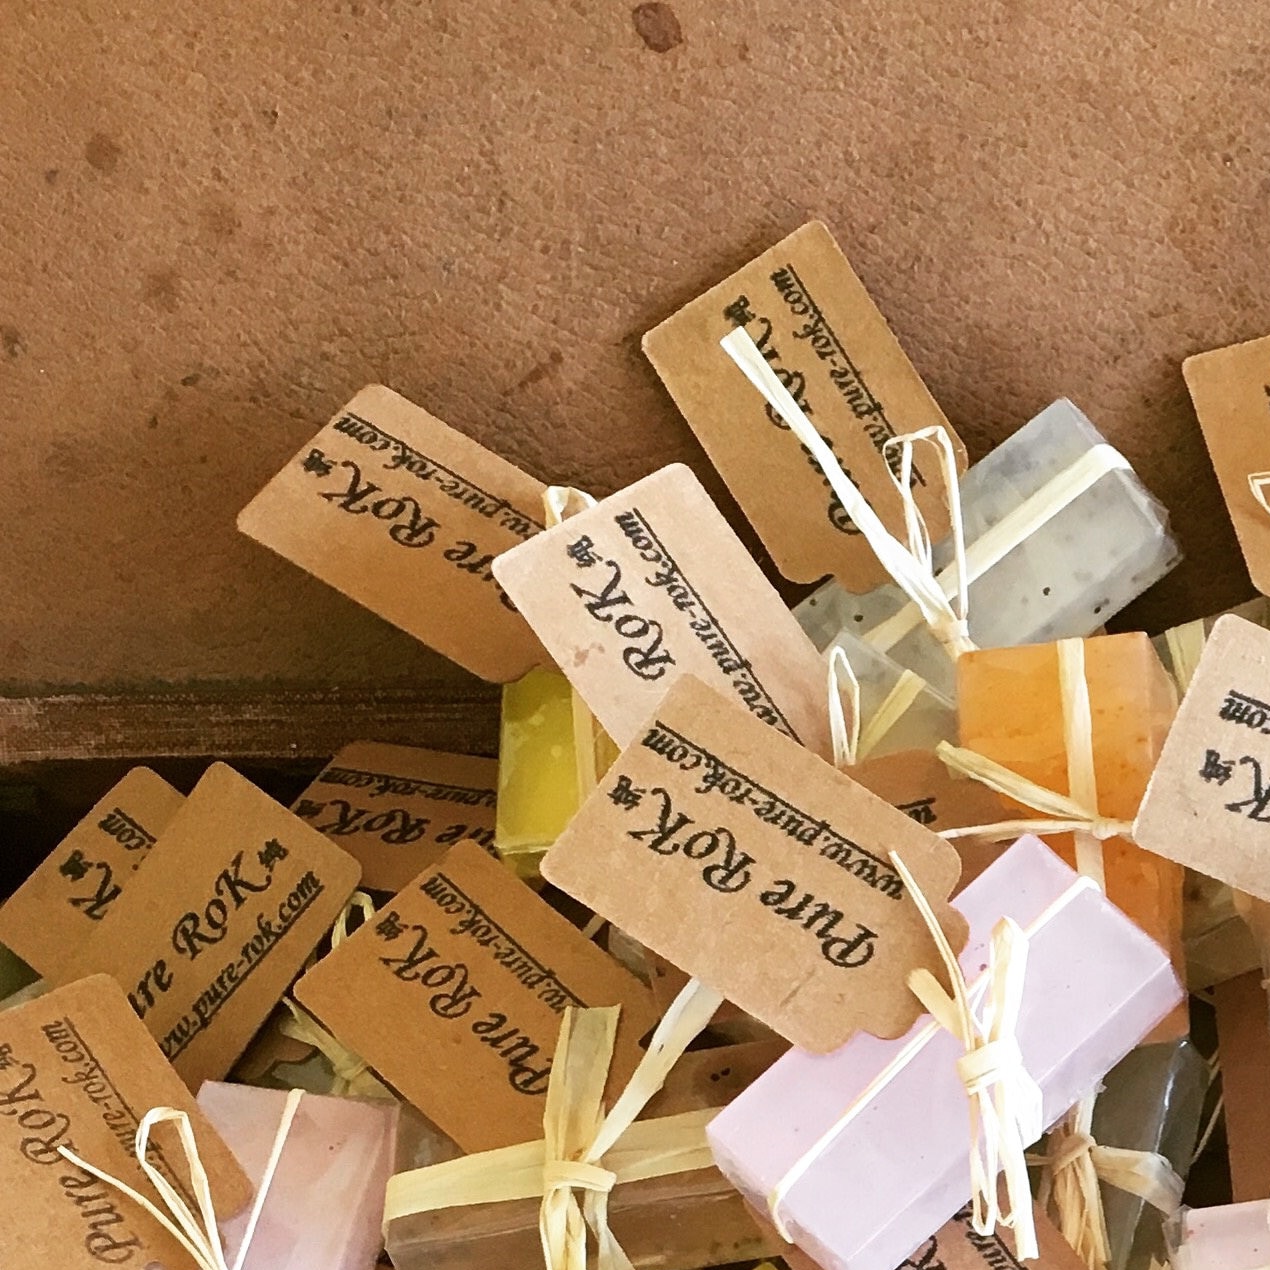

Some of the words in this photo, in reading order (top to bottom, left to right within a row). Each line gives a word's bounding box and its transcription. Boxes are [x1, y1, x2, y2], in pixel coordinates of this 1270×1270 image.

[317, 460, 441, 548] RoK
[570, 560, 676, 681] RoK
[315, 800, 431, 844] RoK
[628, 787, 757, 893] RoK
[642, 720, 904, 899] www.pure-rok.com
[172, 851, 272, 961] RoK
[759, 879, 879, 968] Pure
[379, 925, 482, 1019] RoK
[472, 1012, 553, 1095] Pure
[59, 1174, 142, 1264] Pure
